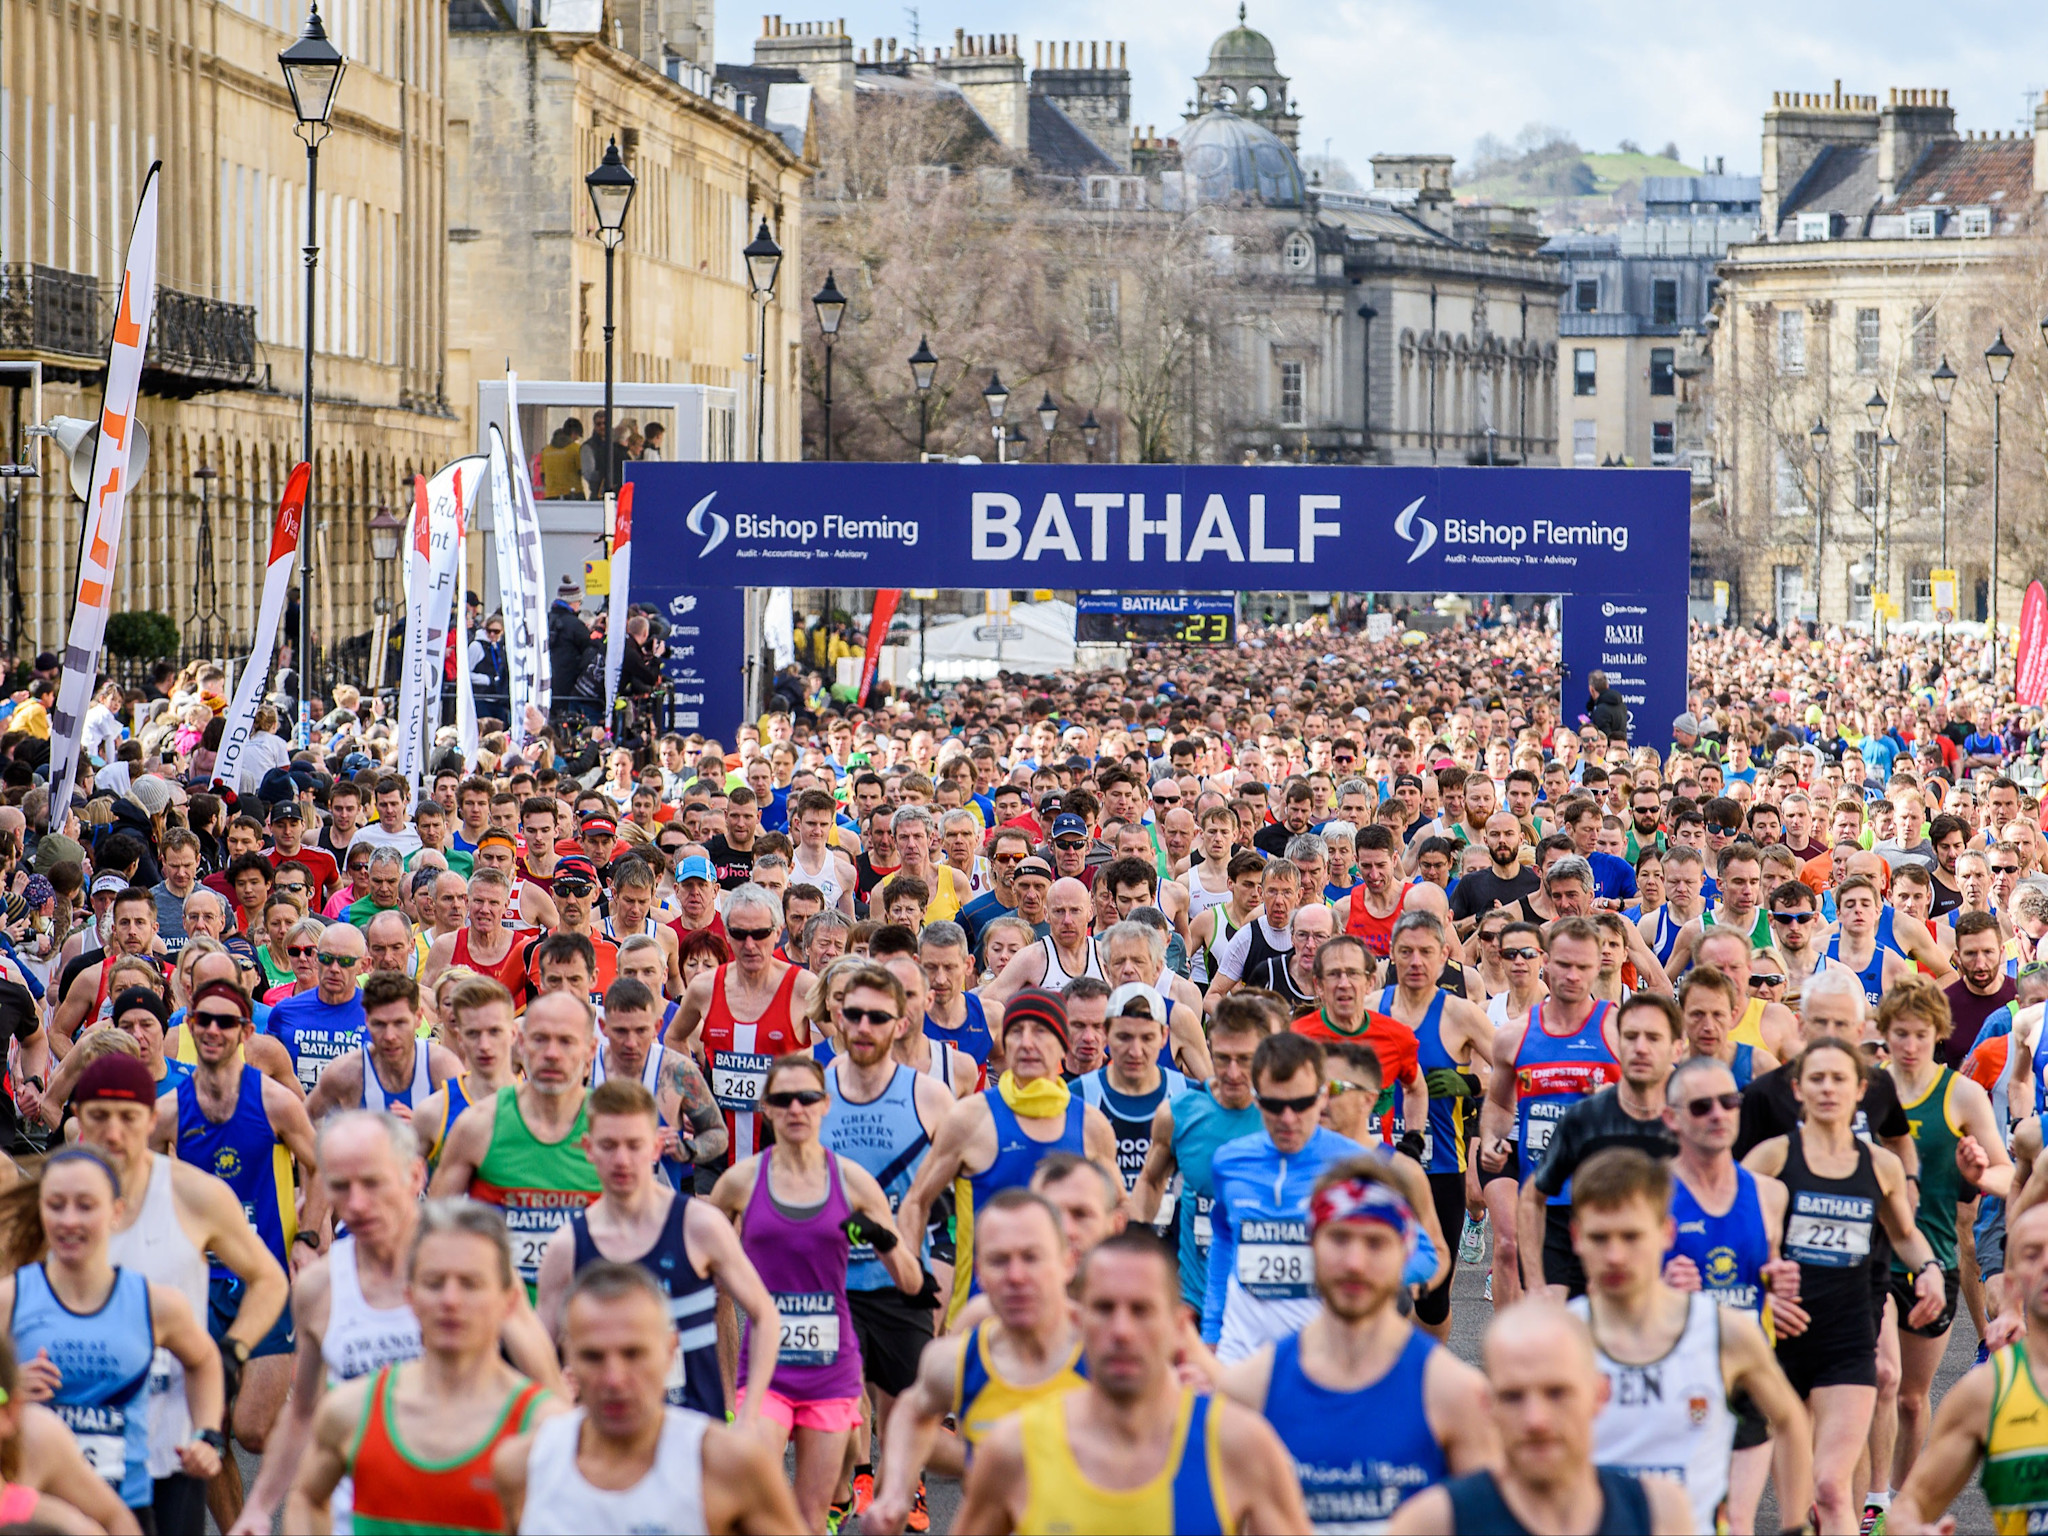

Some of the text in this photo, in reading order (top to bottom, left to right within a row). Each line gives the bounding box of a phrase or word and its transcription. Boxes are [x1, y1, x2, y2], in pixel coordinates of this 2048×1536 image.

[735, 514, 919, 546] Bishop Fleming
[971, 492, 1341, 562] BATHALF
[1445, 519, 1629, 552] Bishop Fleming
[736, 549, 868, 560] Audit Accountancy Tax Advisory
[1445, 554, 1578, 566] Audit Accountancy Tax Advisory
[1122, 597, 1188, 612] BATHALF
[1605, 625, 1644, 638] BATH
[716, 1053, 772, 1071] BATHALF
[1532, 1067, 1591, 1079] CHEPSTOW
[725, 1078, 756, 1099] 248
[840, 1114, 884, 1127] GREAT
[831, 1124, 895, 1140] WESTERN
[832, 1136, 895, 1151] RUNNERS
[505, 1191, 587, 1209] STROUD
[1797, 1195, 1873, 1219] BATHALF
[1242, 1221, 1309, 1243] BATHAL
[1808, 1224, 1847, 1249] 224
[1259, 1255, 1302, 1281] 298
[775, 1294, 835, 1313] ATHALF
[780, 1325, 819, 1347] 256
